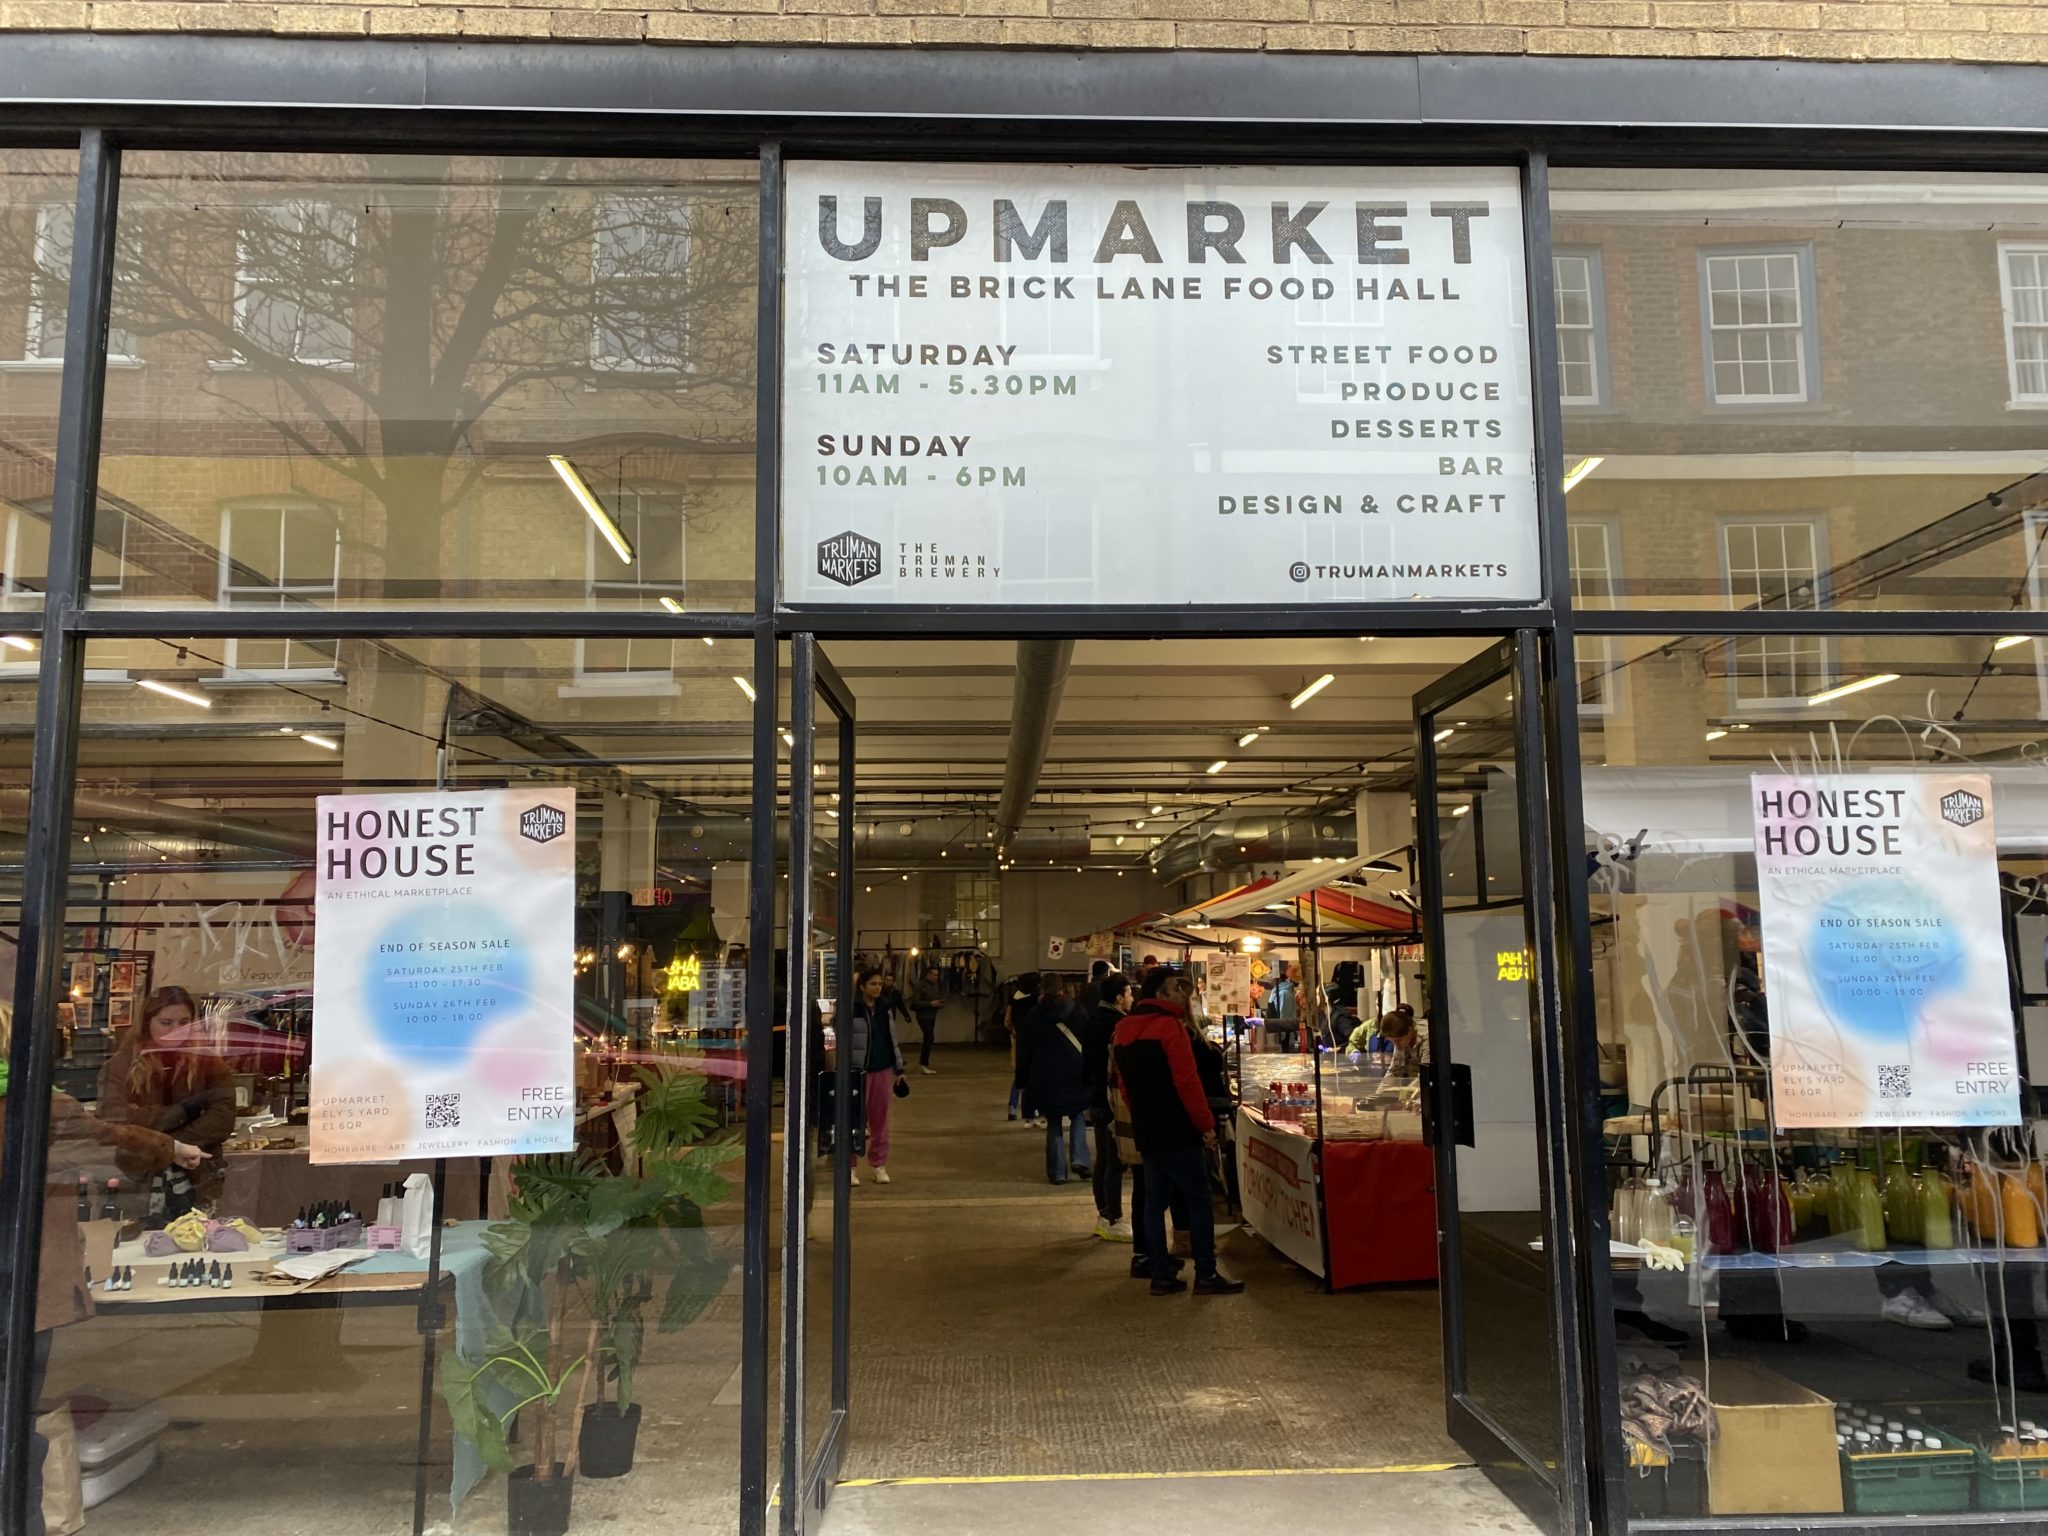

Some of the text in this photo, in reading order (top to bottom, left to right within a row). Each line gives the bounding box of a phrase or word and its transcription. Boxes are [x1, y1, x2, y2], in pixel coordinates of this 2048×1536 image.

[818, 195, 1490, 264] UPMARKET
[850, 275, 1461, 300] THE BRICK LANE FOOD HALL
[817, 343, 1018, 366] SATURDAY
[1267, 345, 1499, 365] STREET FOOD
[817, 374, 900, 394] 11AM
[948, 375, 1078, 396] 5.30PM
[1341, 382, 1500, 401] PRODUCE
[1332, 419, 1503, 439] DESSERTS
[817, 435, 972, 457] SUNDAY
[1439, 456, 1504, 475] BAR
[817, 465, 908, 486] 10AM
[956, 466, 1026, 487] 6PM
[1218, 494, 1506, 514] DESIGN & CRAFT
[822, 535, 878, 562] TRUMAN
[899, 543, 938, 554] THE
[899, 555, 986, 566] TRUMAN
[821, 557, 878, 583] MARKETS
[899, 567, 1001, 578] BREWERY
[1315, 563, 1508, 579] TRUMANMARKETS
[1762, 789, 1906, 818] HONEST
[1944, 792, 1982, 810] TRUMAN
[327, 806, 484, 841] HONEST
[523, 807, 563, 826] TRUMAN
[1943, 806, 1983, 824] MARKETS
[522, 821, 564, 840] MARKETS
[1765, 825, 1903, 856] HOUSE
[327, 843, 476, 880] HOUSE
[1768, 866, 1902, 875] AN ETHICAL MARKETPLACE
[327, 887, 473, 899] AN ETHICAL MARKETPLACE
[1820, 918, 1943, 928] END OF SEASON SALE
[380, 939, 511, 953] END OF SEASON SALE
[1828, 941, 1939, 950] SATURDAY 25TH FEB
[386, 963, 504, 976] SATURDAY 25TH FEB
[1838, 975, 1880, 983] SUNDAY
[1885, 975, 1912, 983] 26TH
[393, 998, 497, 1010] SUNDAY 26TH FEB
[1967, 1062, 2008, 1075] FREE
[1816, 1075, 1845, 1083] YARD
[1956, 1080, 2009, 1095] ENTRY
[521, 1087, 564, 1102] FREE
[1785, 1088, 1822, 1096] E1 6QR
[322, 1107, 389, 1118] ELY'S YARD
[508, 1105, 564, 1121] ENTRY
[1788, 1111, 1838, 1119] HOMEWARE
[1874, 1110, 1922, 1118] JEWELLERY
[322, 1121, 362, 1131] E1 6QR
[324, 1144, 377, 1154] HOMEWARE
[388, 1143, 406, 1151] ART
[417, 1140, 470, 1150] JEWELLERY
[477, 1137, 517, 1147] FASHION
